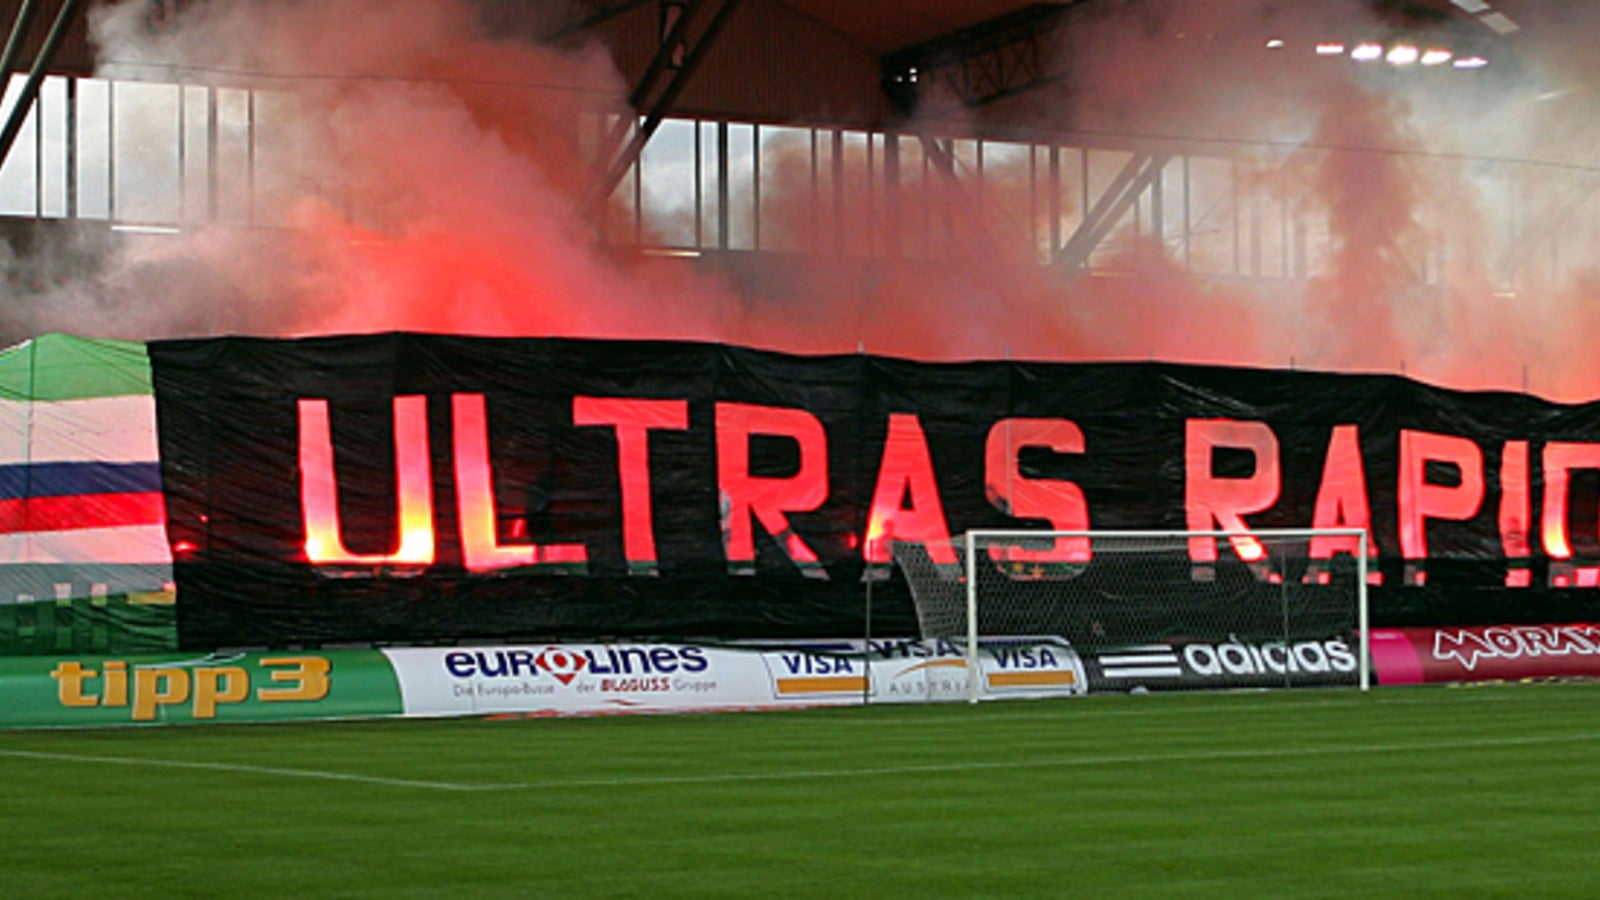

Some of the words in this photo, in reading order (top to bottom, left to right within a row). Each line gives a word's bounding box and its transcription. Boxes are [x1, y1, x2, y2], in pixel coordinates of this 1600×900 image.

[297, 392, 1093, 580] ULTRAS
[783, 654, 853, 674] VISA
[989, 647, 1059, 668] VISA
[1184, 634, 1357, 675] adidas
[51, 656, 331, 720] tipp3
